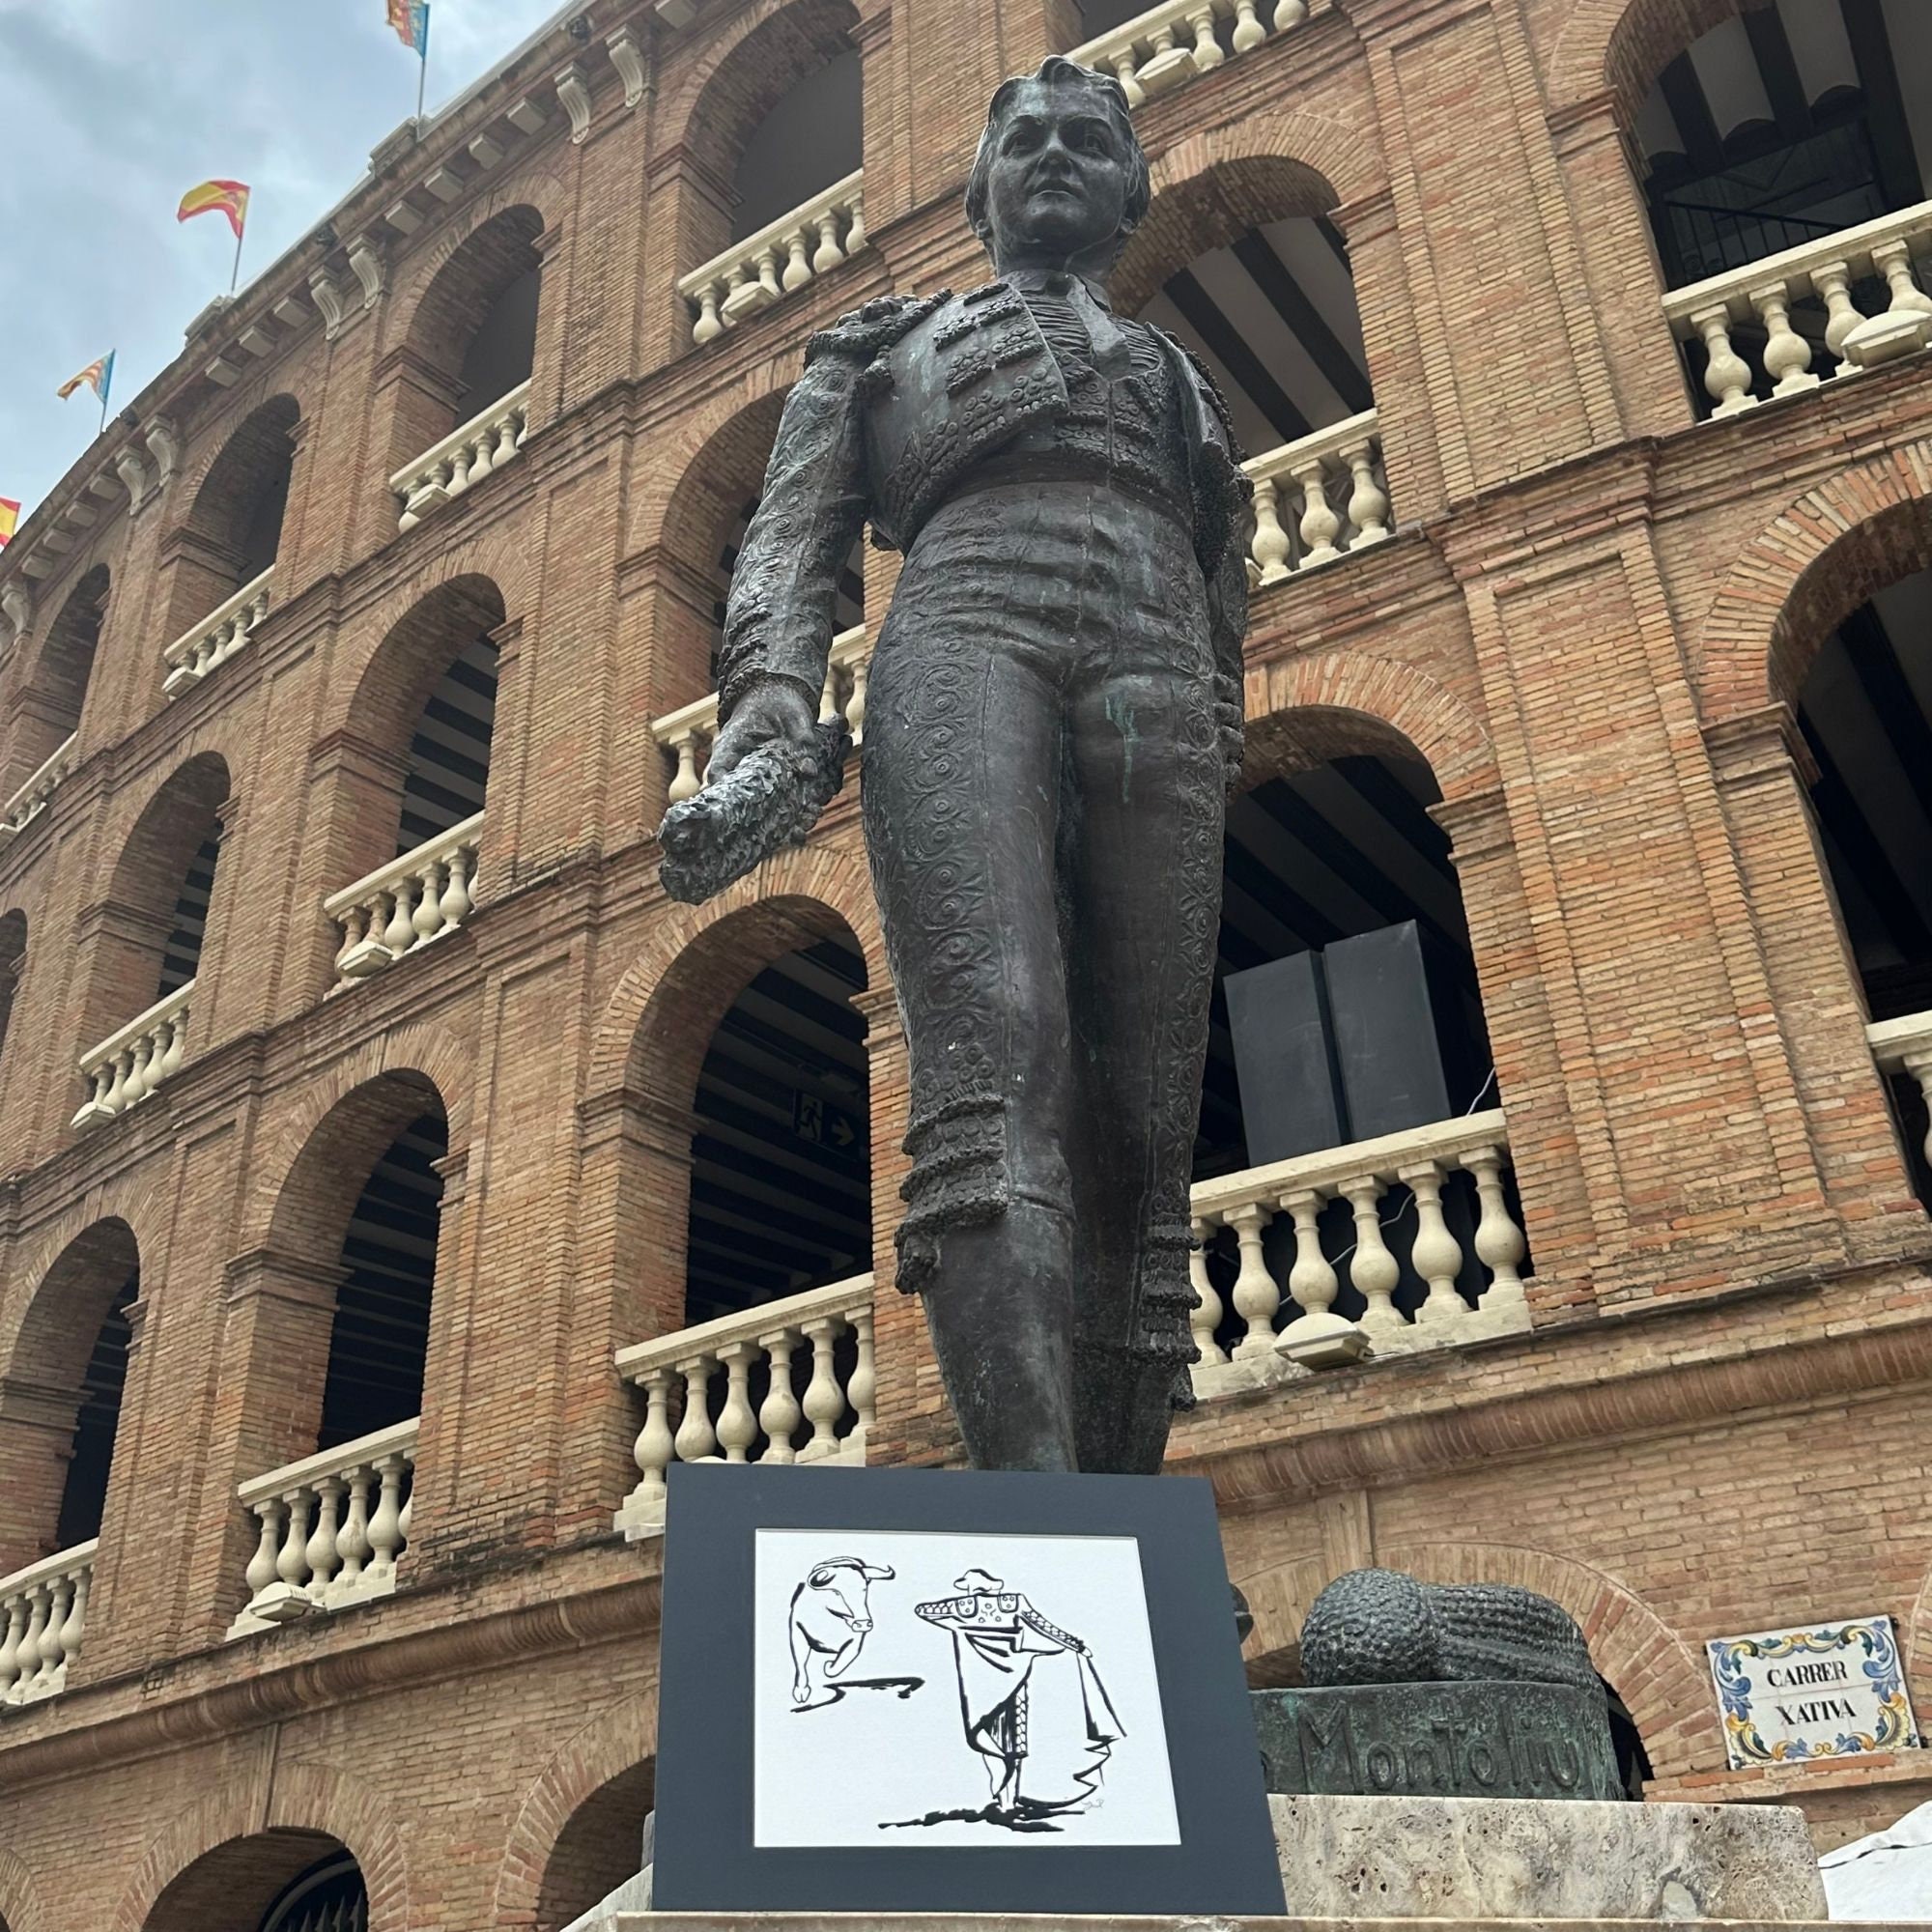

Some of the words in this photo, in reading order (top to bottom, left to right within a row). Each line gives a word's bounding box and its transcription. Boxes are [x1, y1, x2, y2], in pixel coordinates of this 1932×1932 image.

[1767, 1661, 1847, 1687] CARRER
[1775, 1698, 1857, 1725] XATIVA
[1296, 1695, 1580, 1794] Montoliu
